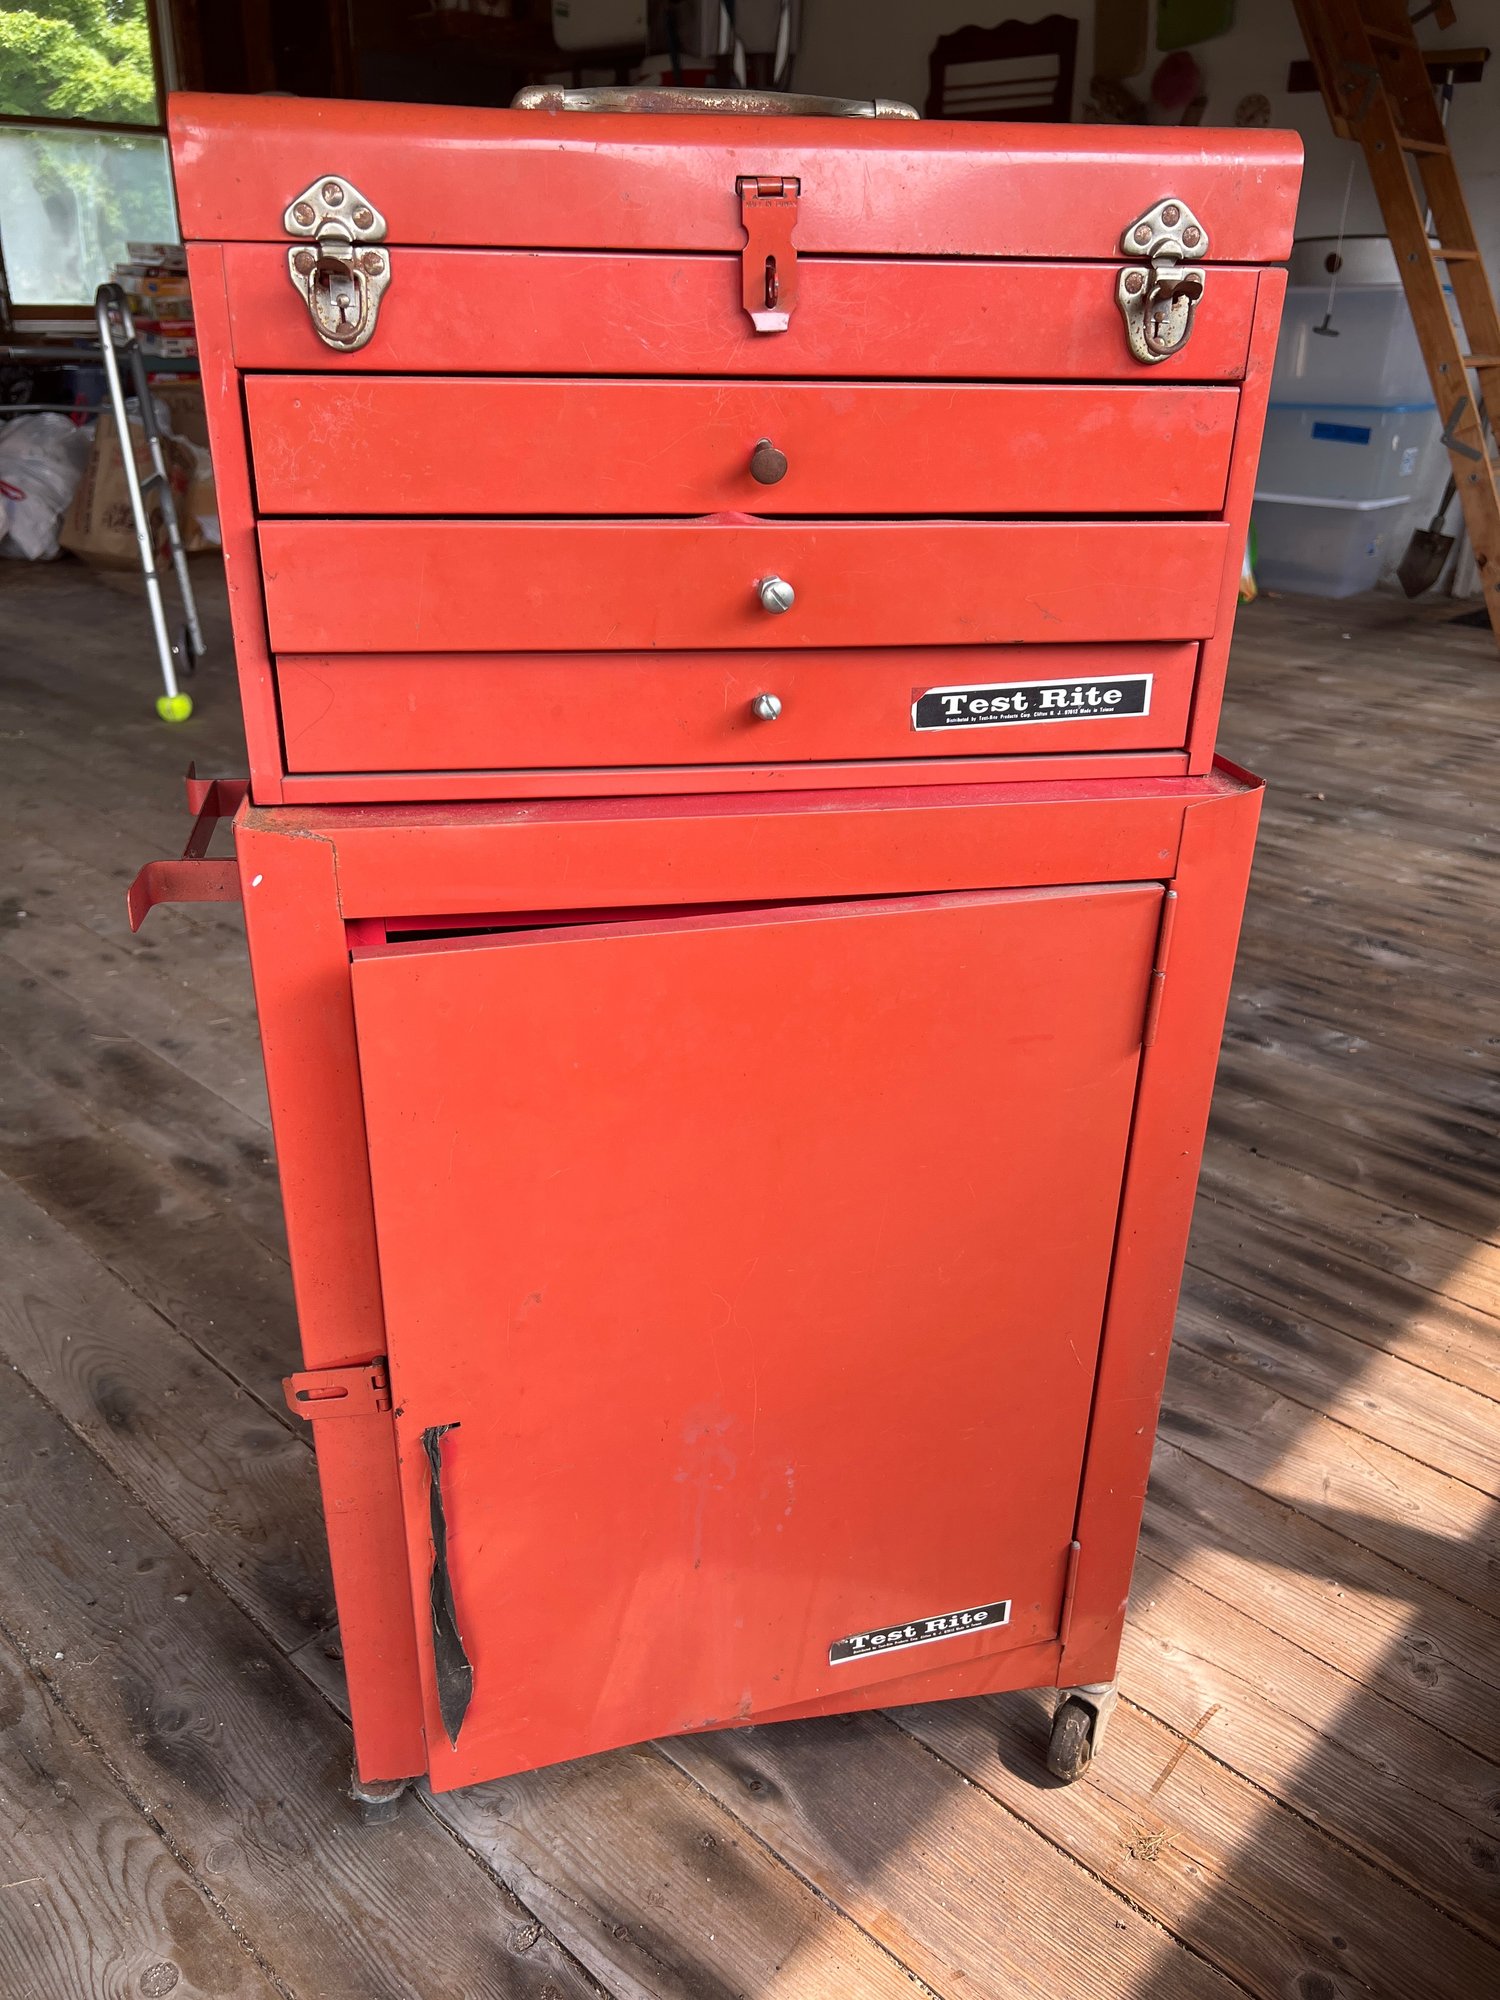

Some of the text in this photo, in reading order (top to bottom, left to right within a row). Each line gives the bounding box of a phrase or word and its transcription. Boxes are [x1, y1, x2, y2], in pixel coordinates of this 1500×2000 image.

[941, 686, 1122, 715] Test Rite
[850, 1626, 917, 1649] Test
[924, 1611, 989, 1634] Rite
